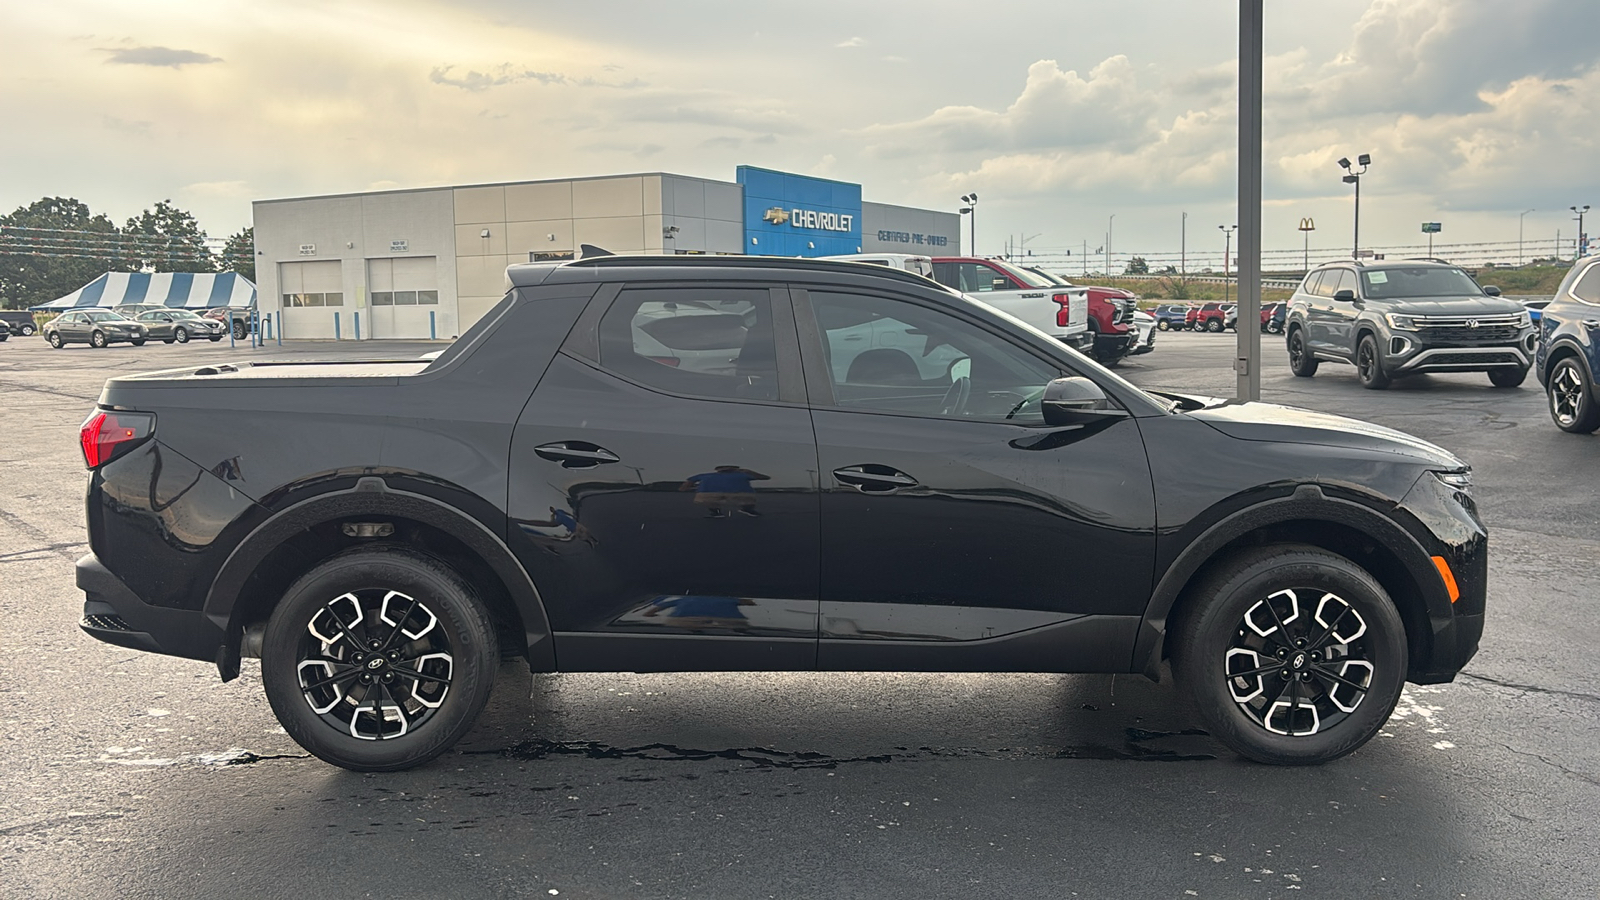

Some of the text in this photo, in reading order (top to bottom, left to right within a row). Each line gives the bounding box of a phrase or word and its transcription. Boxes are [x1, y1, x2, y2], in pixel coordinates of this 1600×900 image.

[792, 209, 853, 232] CHEVROLET
[877, 230, 910, 244] CERTIFIED
[431, 590, 470, 645] KUMHO
